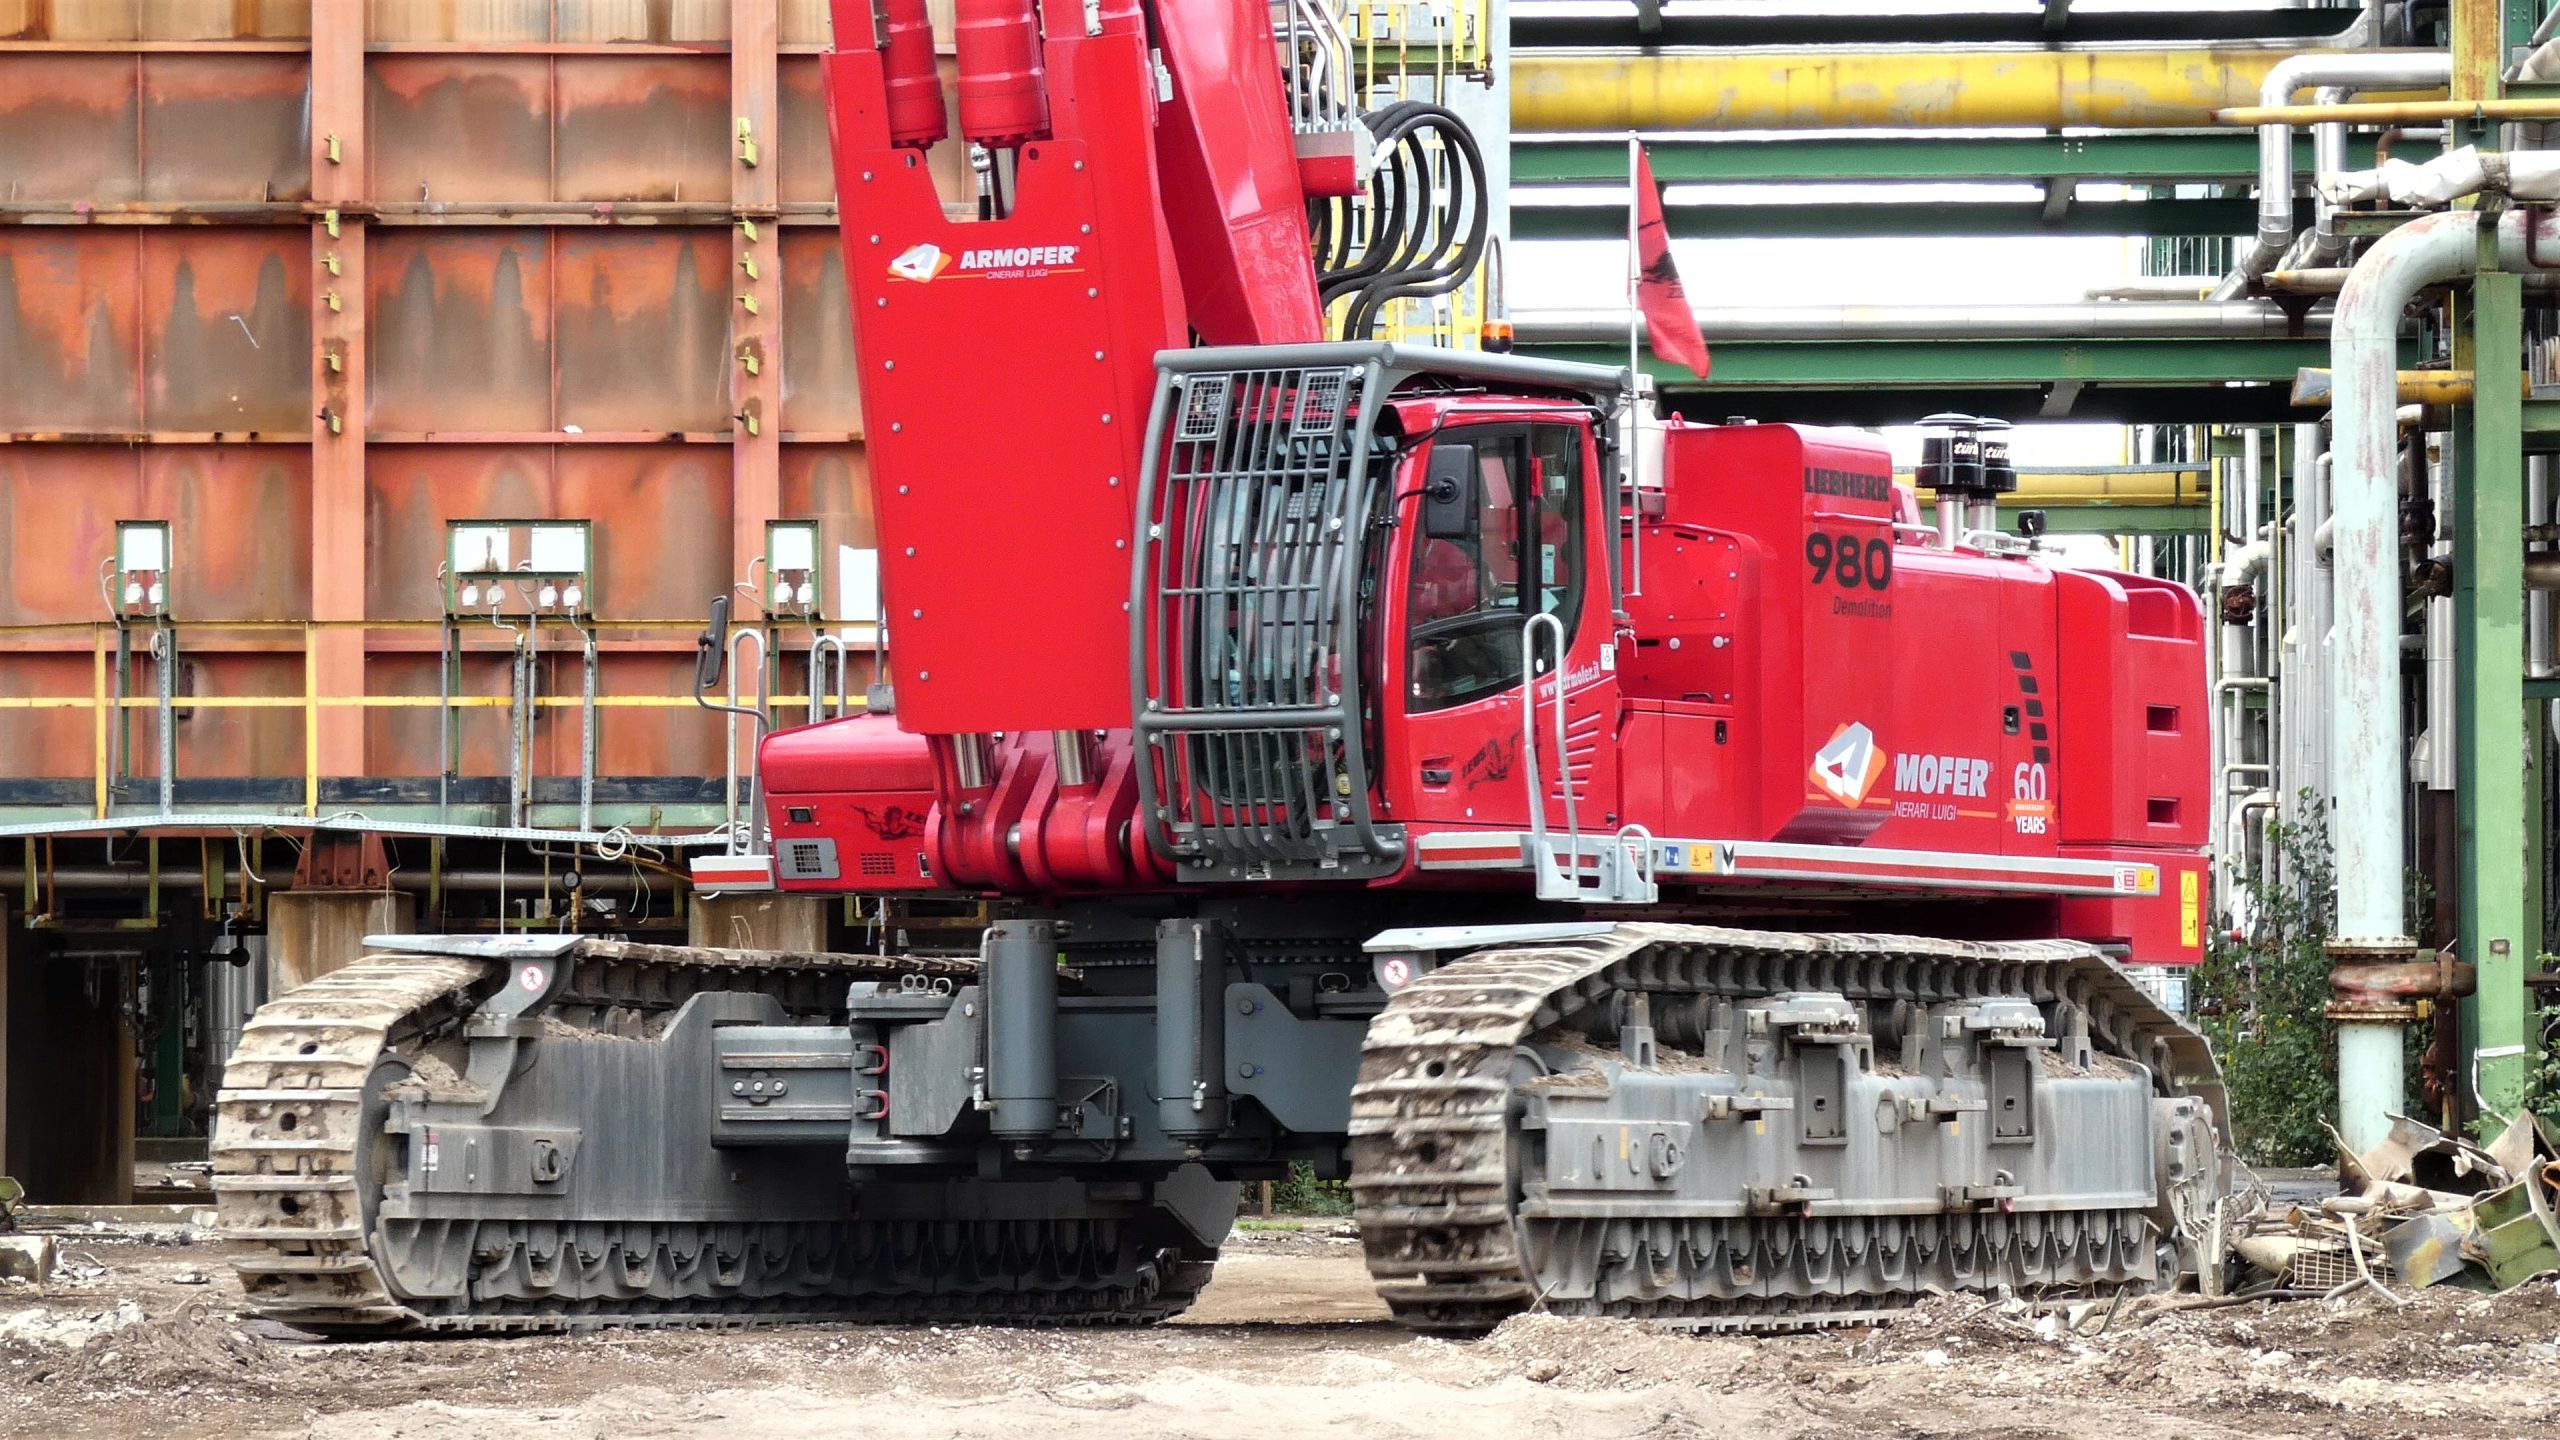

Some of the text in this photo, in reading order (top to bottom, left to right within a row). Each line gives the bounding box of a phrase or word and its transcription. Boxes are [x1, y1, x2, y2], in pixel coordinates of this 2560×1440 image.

[960, 245, 1075, 269] ARMOFER
[986, 269, 1048, 280] CINERARI LUIGI
[1804, 467, 1889, 502] LIEBHERR
[1805, 532, 1891, 591] 980
[1832, 596, 1892, 618] Demolition
[1894, 753, 1989, 798] MOFER
[2014, 762, 2046, 801] 60
[1893, 801, 1957, 821] NERARI LUIGI
[2015, 815, 2046, 835] YEARS
